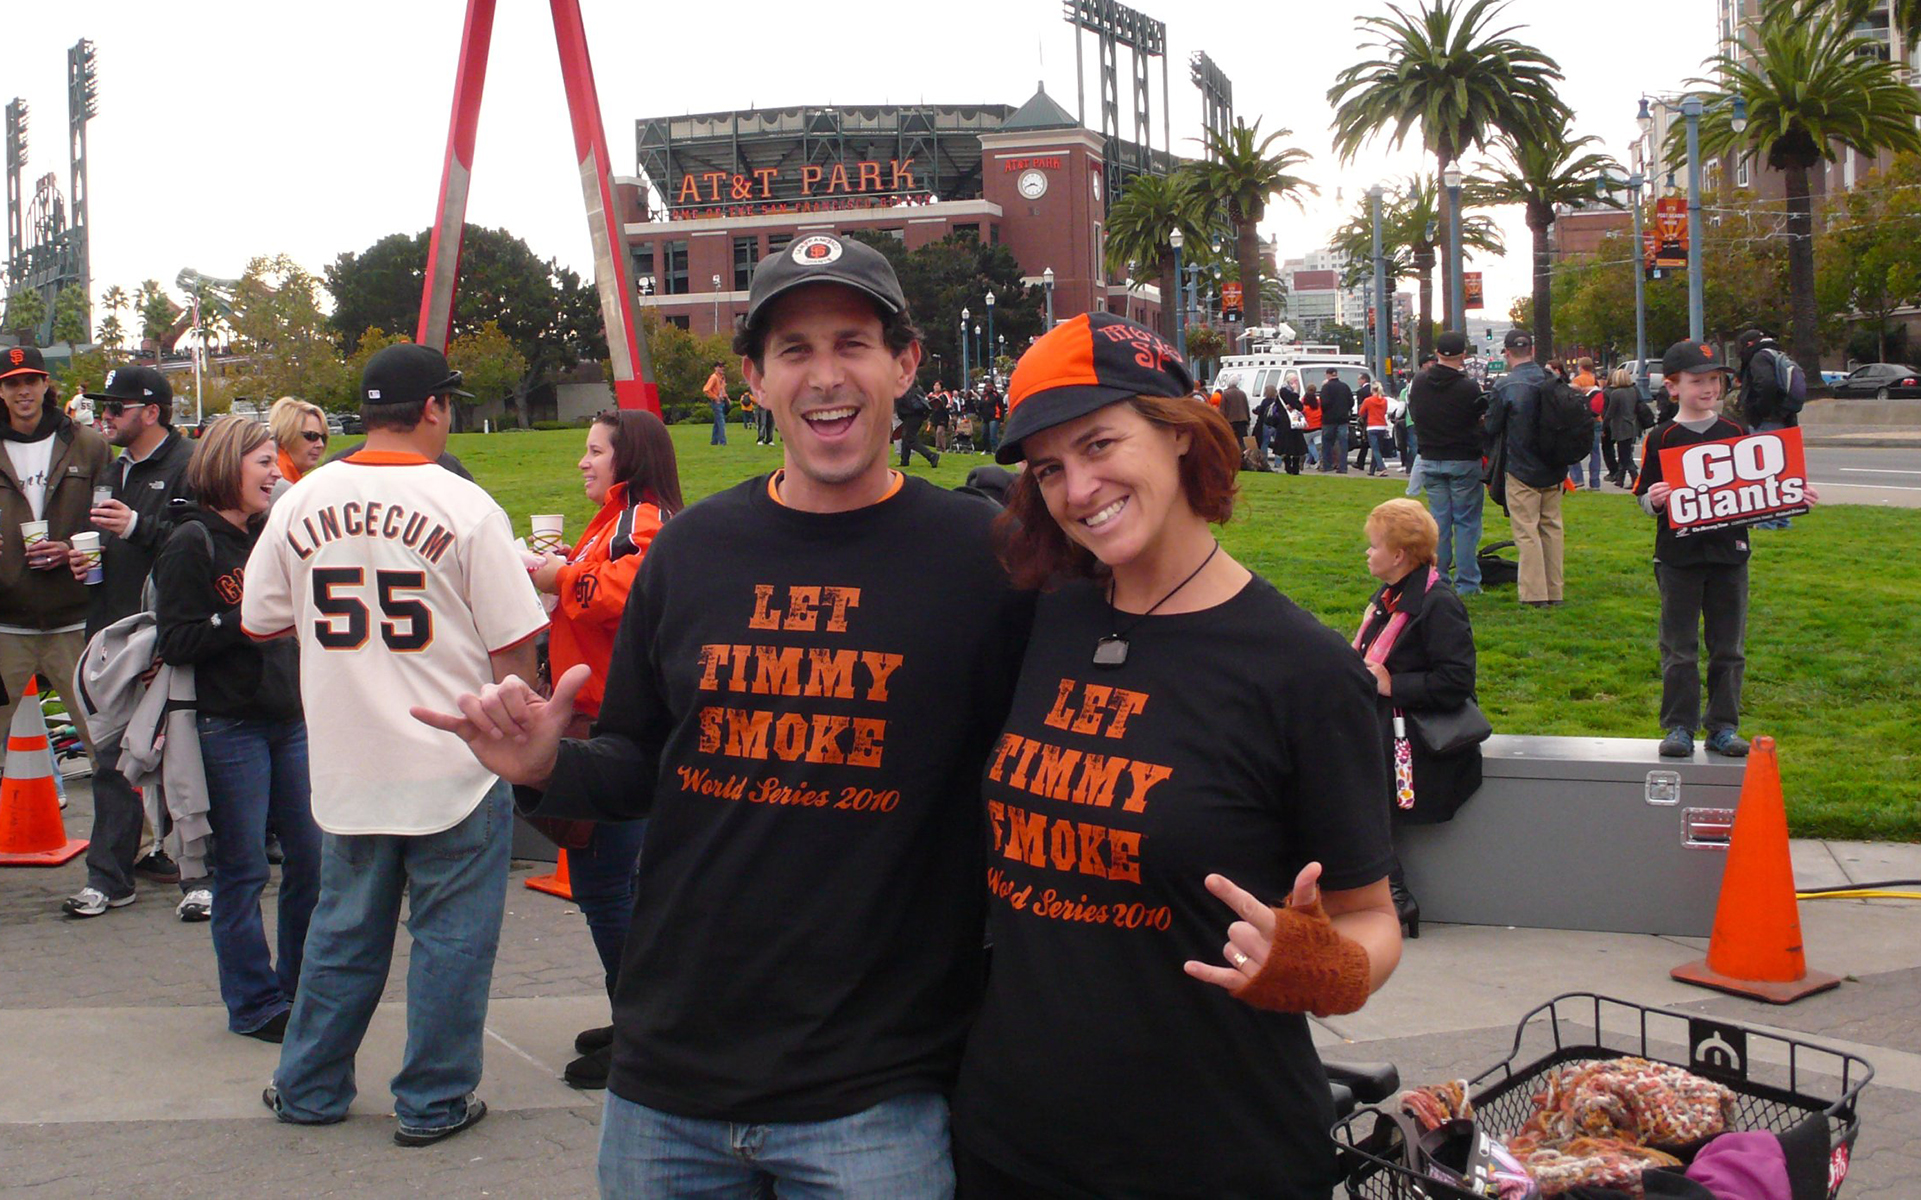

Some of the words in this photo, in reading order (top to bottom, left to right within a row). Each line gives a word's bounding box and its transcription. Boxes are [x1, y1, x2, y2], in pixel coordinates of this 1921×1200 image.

[677, 167, 778, 204] AT&T
[800, 158, 916, 195] PARK
[1003, 159, 1029, 173] AT&T
[1033, 156, 1062, 170] PARK
[1682, 434, 1786, 489] GO
[1669, 474, 1805, 524] Giants
[286, 501, 456, 565] LINCECUM
[312, 566, 434, 653] 55
[748, 584, 861, 633] LET
[697, 644, 904, 702] TIMMY
[1043, 678, 1150, 739] LET
[698, 706, 887, 768] SMOKE
[676, 765, 748, 800] World
[748, 777, 830, 806] Series
[833, 786, 900, 813] 2010
[988, 732, 1174, 814] TIMMY
[1032, 888, 1109, 923] Series
[1112, 902, 1172, 931] 2010
